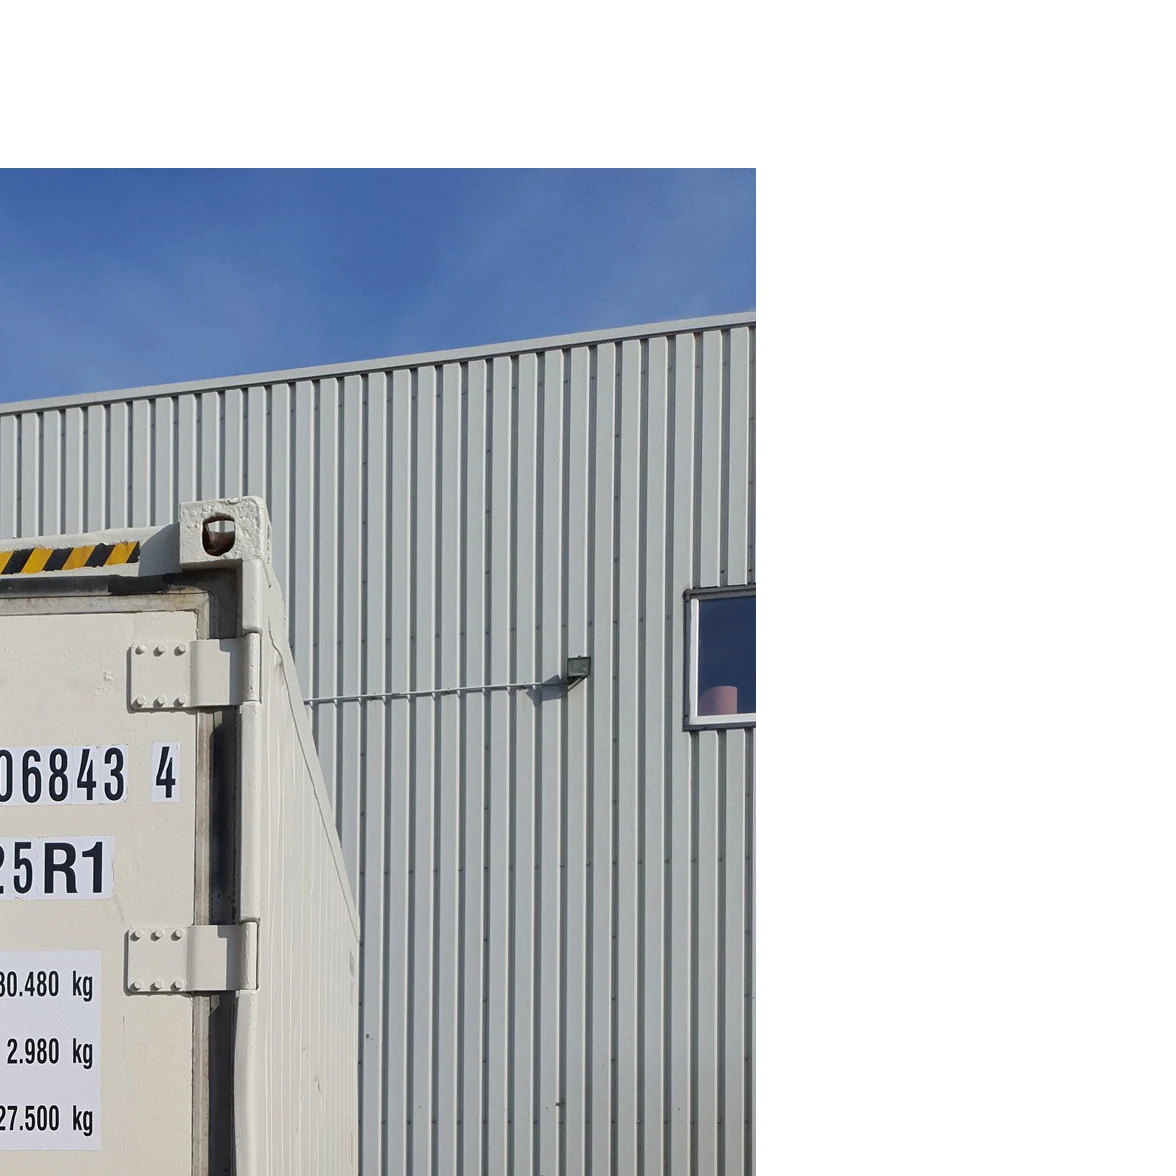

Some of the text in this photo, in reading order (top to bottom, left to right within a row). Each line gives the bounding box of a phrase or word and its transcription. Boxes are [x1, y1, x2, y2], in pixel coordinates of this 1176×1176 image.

[155, 746, 176, 799] 4
[72, 970, 93, 1002] kg
[7, 1037, 60, 1065] 2.980
[72, 1037, 93, 1070] kg
[72, 1104, 93, 1137] kg
